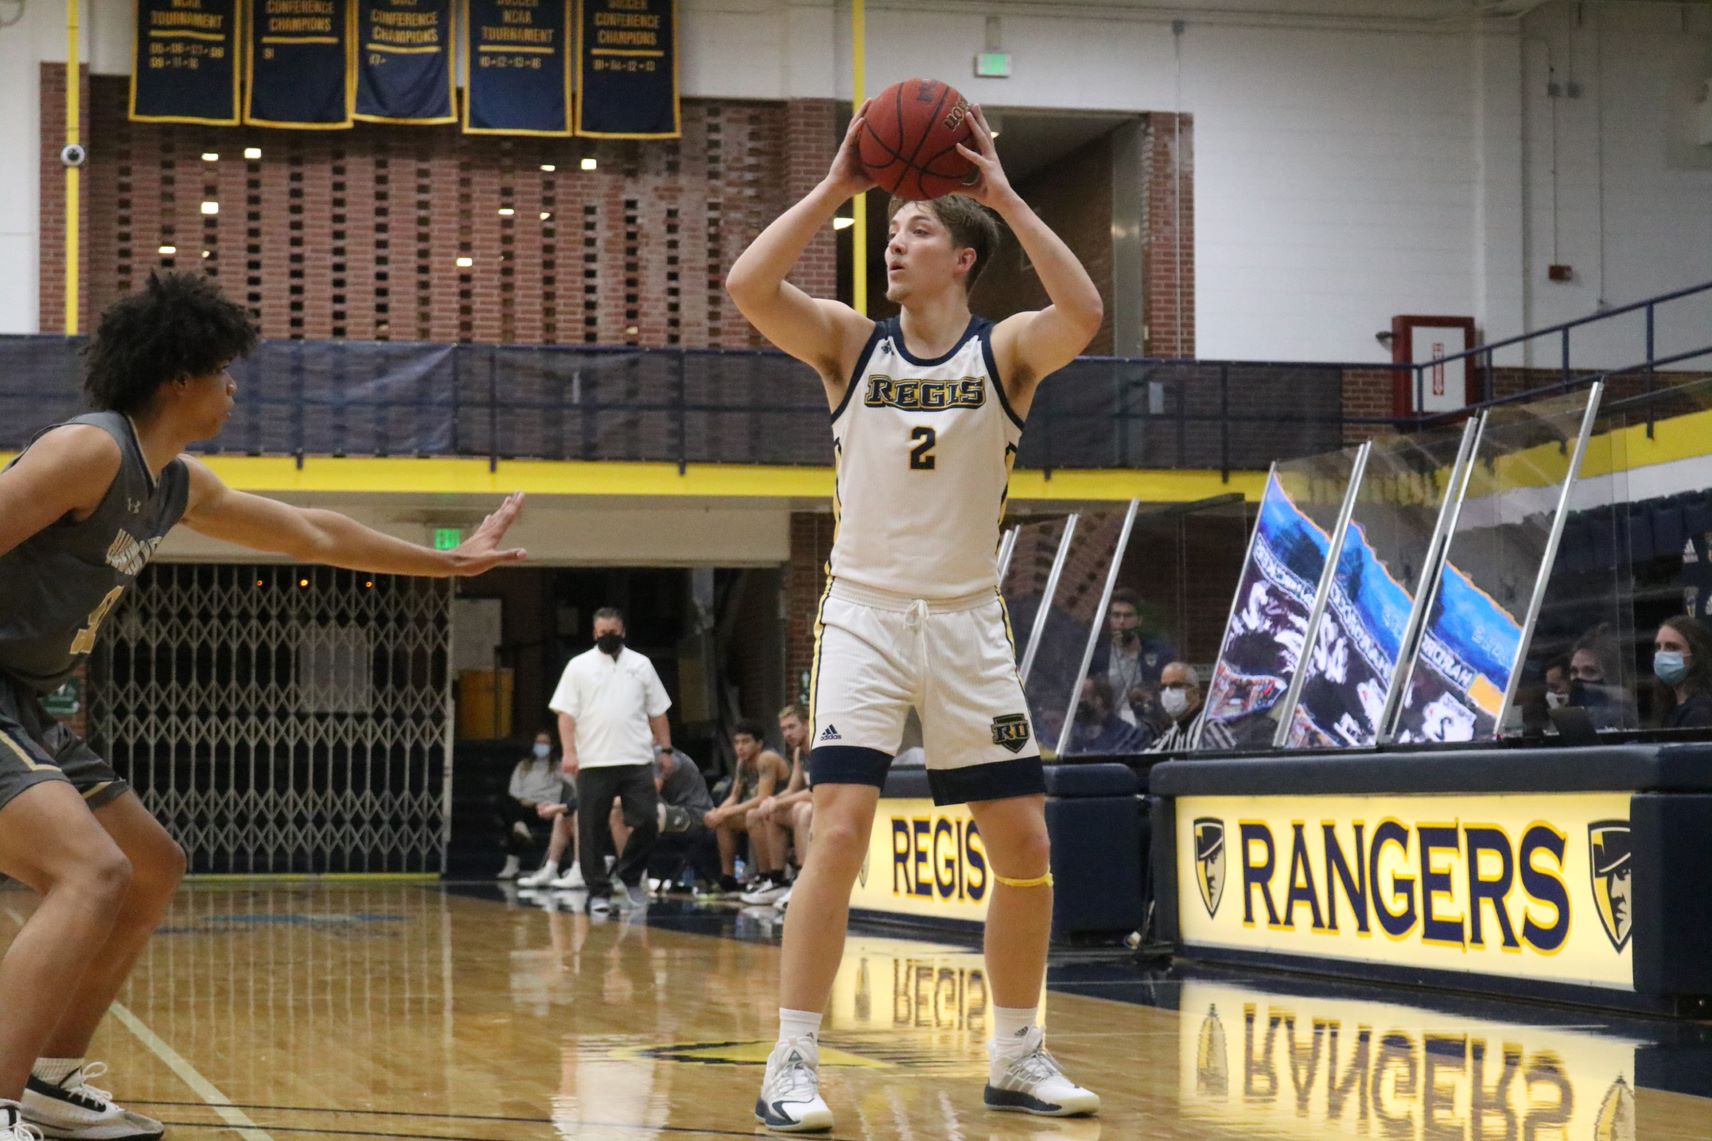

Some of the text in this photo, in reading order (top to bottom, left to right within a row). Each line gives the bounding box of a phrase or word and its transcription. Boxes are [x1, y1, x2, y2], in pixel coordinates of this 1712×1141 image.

[265, 1, 335, 13] CONFERENCE
[151, 11, 224, 28] TOURNAMENT
[269, 17, 332, 31] CHAMPIONS
[371, 9, 439, 26] CONFERENCE
[503, 10, 532, 24] NCAA
[595, 13, 660, 28] CONFERENCE
[372, 26, 439, 43] CHAMPIONS
[482, 26, 554, 42] TOURNAMENT
[597, 30, 657, 46] CHAMPIONS
[864, 374, 987, 412] REGIS
[909, 425, 937, 470] 2
[891, 815, 987, 905] REGIS
[1239, 816, 1571, 957] RANGERS
